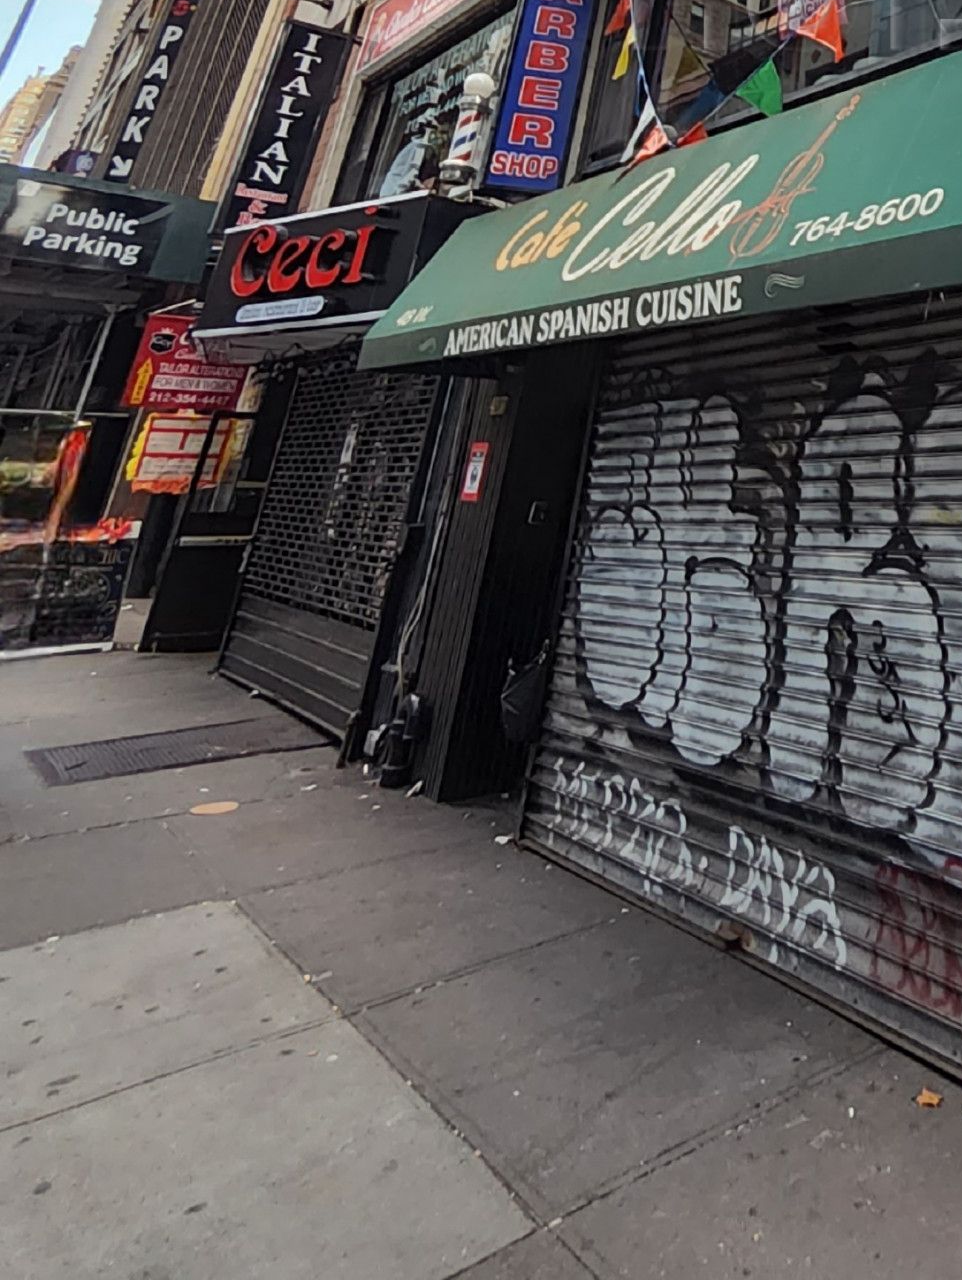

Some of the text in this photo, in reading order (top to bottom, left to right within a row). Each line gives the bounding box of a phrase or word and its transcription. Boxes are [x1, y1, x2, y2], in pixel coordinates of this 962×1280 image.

[122, 25, 184, 143] PARK
[250, 32, 323, 185] ITALIAN
[490, 150, 558, 179] SHOP
[23, 226, 143, 266] Parking
[46, 203, 141, 235] Public
[495, 153, 760, 282] Café Cello
[789, 188, 944, 246] 764-8600
[443, 274, 742, 357] AMERICAN SPANISH CUISINE
